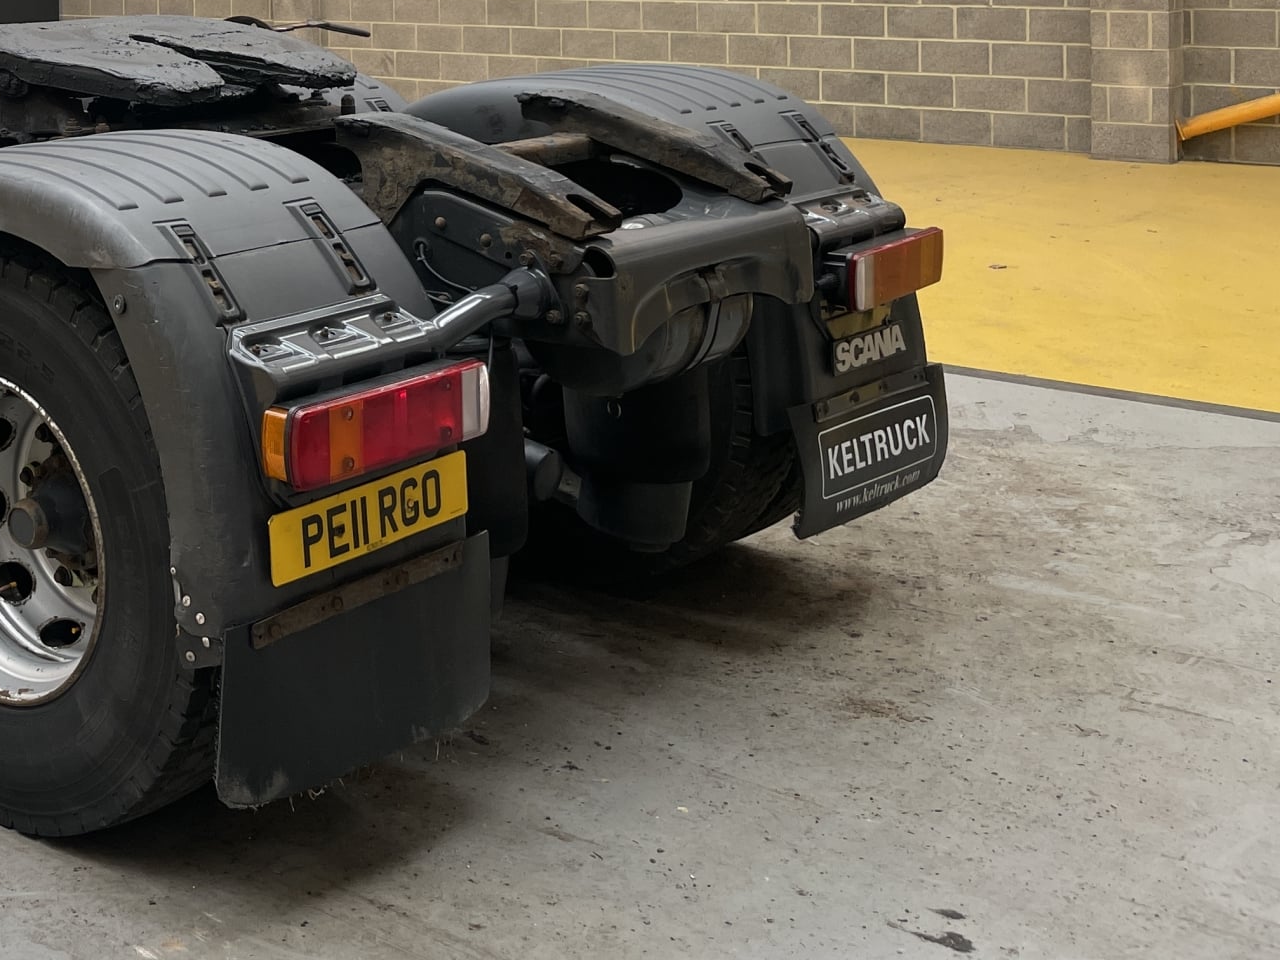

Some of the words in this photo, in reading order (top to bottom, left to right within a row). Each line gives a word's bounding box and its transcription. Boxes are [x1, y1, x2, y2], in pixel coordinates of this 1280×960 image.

[828, 414, 930, 480] KELTRUCK
[378, 469, 441, 538] RGO
[836, 470, 920, 513] www.keltruck.com
